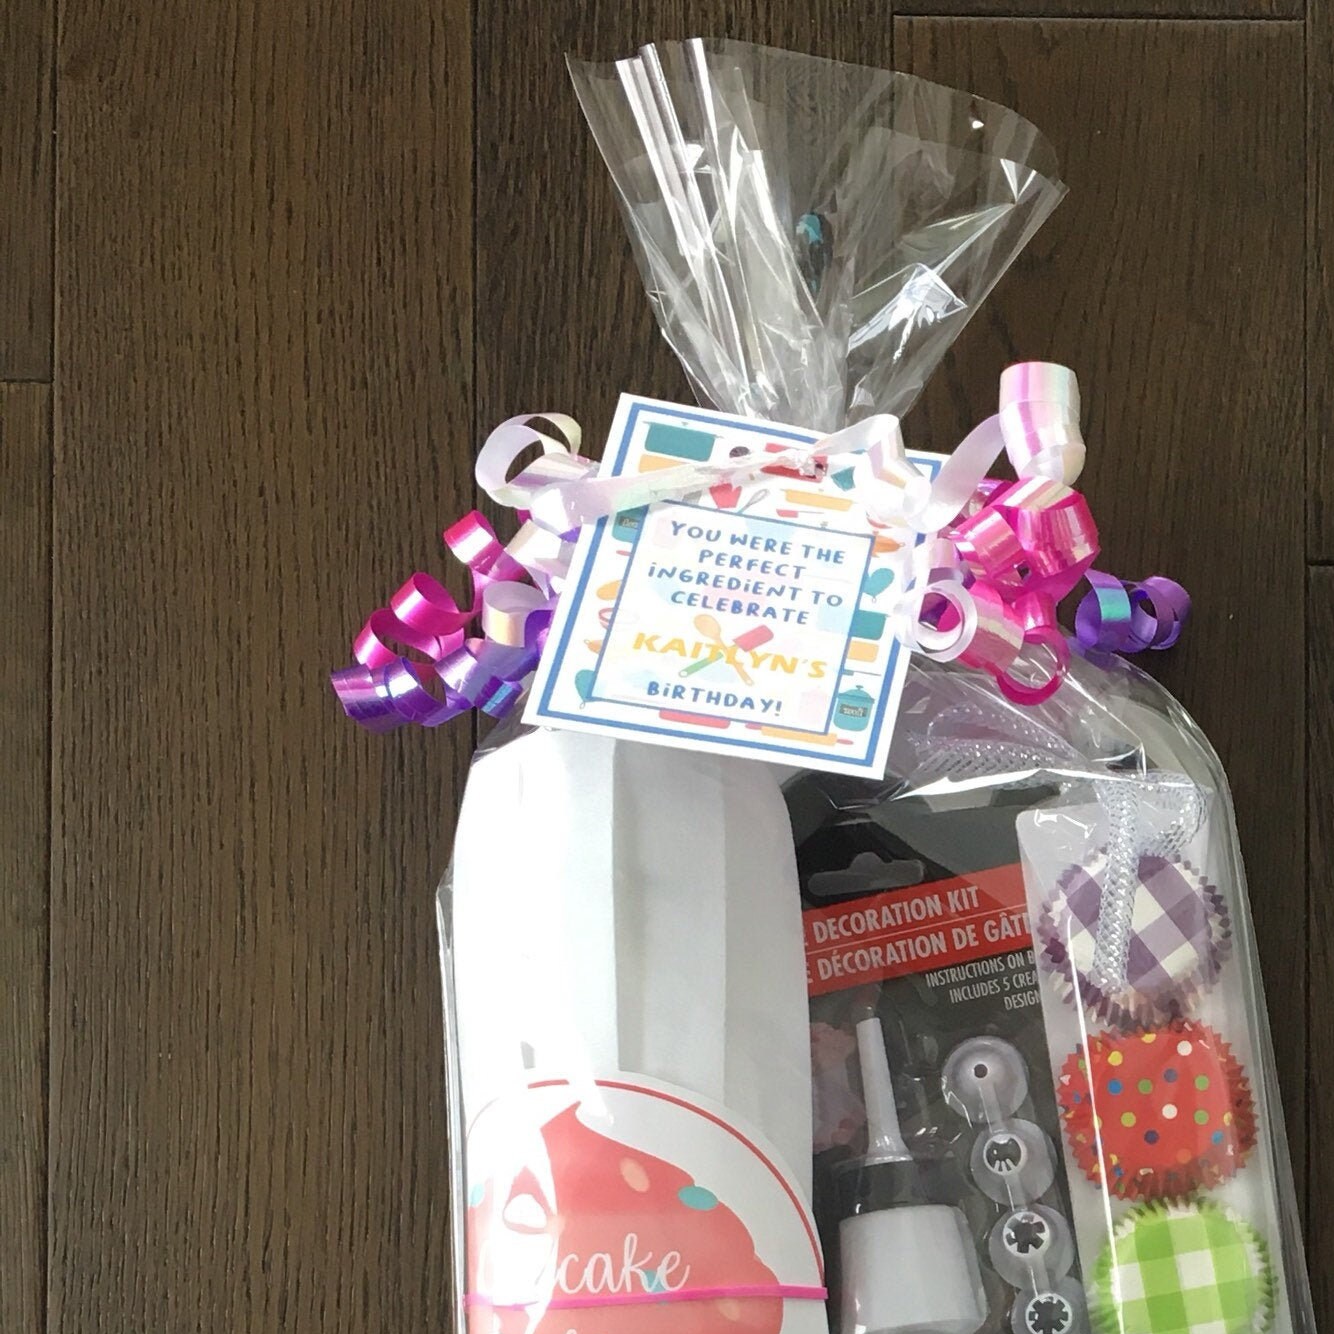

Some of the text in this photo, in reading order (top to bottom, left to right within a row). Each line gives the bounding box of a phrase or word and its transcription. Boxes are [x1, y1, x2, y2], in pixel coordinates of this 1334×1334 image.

[671, 520, 845, 565] YOU WERE THE
[699, 549, 806, 580] PERFECT
[671, 590, 810, 626] CELEBRATE
[811, 590, 843, 608] TO
[633, 632, 828, 678] KAITLYN'S
[812, 886, 979, 944] DECORATION KIT
[817, 932, 947, 981] DÉCORATION
[952, 925, 979, 951] DE
[925, 956, 1005, 988] INSTRUCTIONS
[1007, 952, 1025, 969] ON
[949, 979, 1001, 1004] INCLUDES
[1003, 976, 1011, 991] 5
